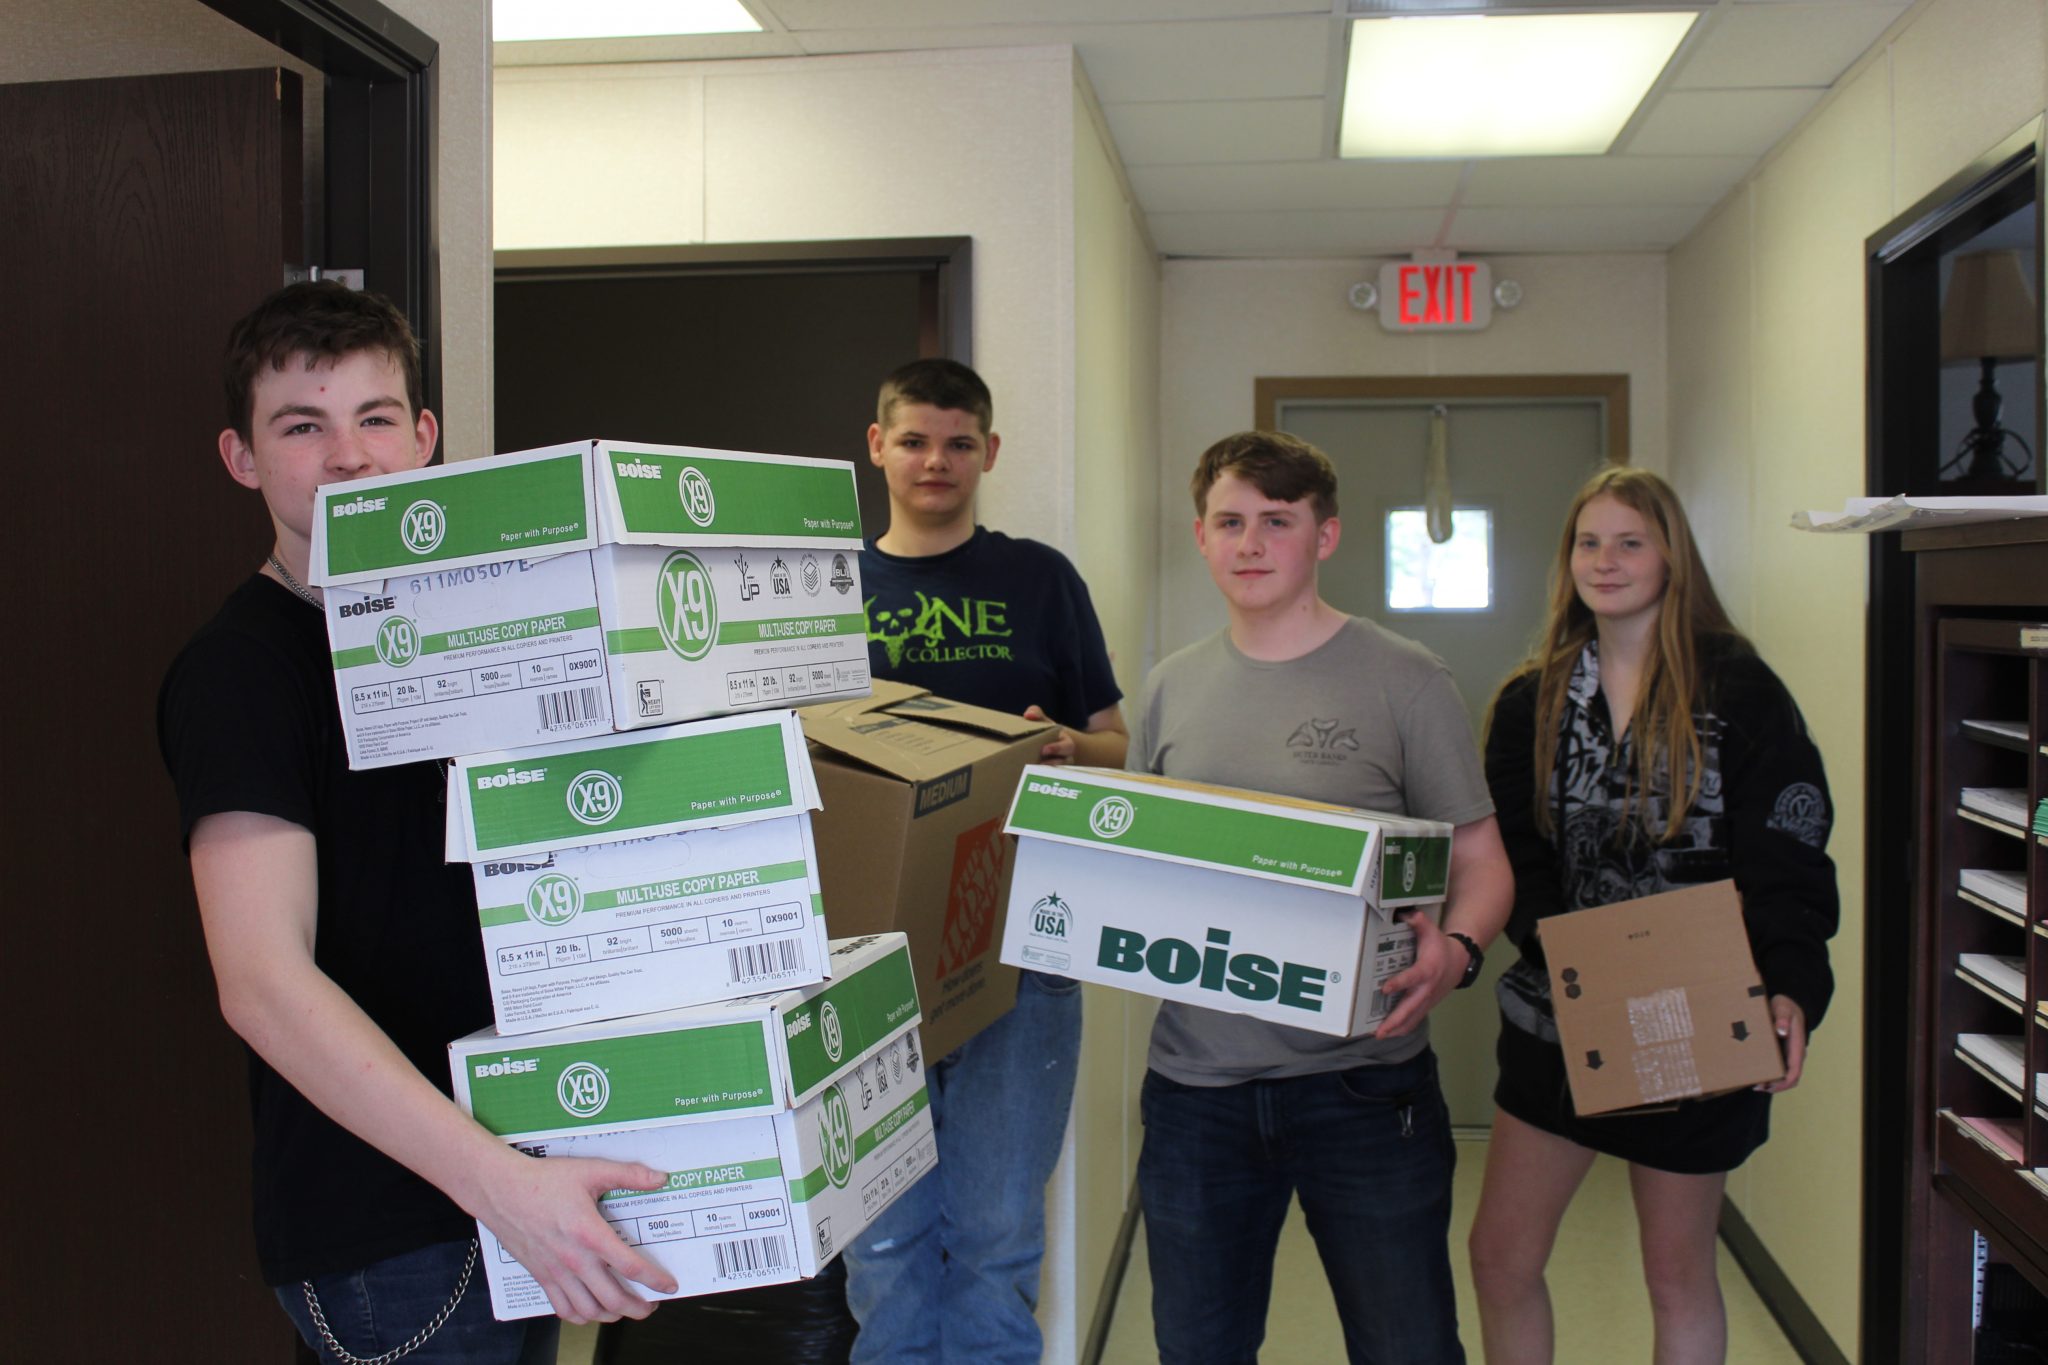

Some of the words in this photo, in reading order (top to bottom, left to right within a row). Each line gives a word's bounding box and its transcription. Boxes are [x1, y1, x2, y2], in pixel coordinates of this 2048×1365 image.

[1399, 265, 1477, 324] EXIT
[803, 517, 819, 529] Paper
[820, 518, 831, 529] with
[500, 530, 523, 543] Paper
[524, 527, 541, 539] with
[773, 577, 791, 595] USA
[447, 626, 499, 648] MULTI-USE
[501, 622, 529, 639] COPY
[531, 615, 567, 635] PAPER
[758, 621, 794, 639] MULTI-USE
[795, 619, 815, 635] COPY
[815, 618, 837, 634] PAPER
[443, 652, 465, 661] PREMIUM
[466, 646, 501, 659] PERFORMANCE
[516, 640, 537, 649] COPIERS
[538, 638, 548, 646] AND
[548, 634, 573, 643] PRINTERS
[906, 644, 1013, 662] COLLECTOR
[480, 671, 499, 681] 5000
[532, 664, 541, 673] 10
[812, 670, 824, 680] 5000
[437, 680, 447, 688] 92
[763, 676, 769, 686] 20
[789, 673, 796, 683] 92
[354, 693, 365, 702] 8.5
[373, 690, 380, 699] 11
[397, 686, 406, 695] 20
[408, 685, 417, 694] lb.
[920, 770, 967, 811] MEDIUM
[691, 799, 717, 811] Paper
[719, 795, 737, 807] with
[1252, 854, 1277, 868] Paper
[1279, 859, 1298, 872] with
[616, 882, 680, 906] MULTI-USE
[682, 876, 717, 895] COPY
[718, 870, 760, 890] PAPER
[615, 909, 642, 919] PREMIUM
[643, 902, 684, 914] PERFORMANCE
[693, 899, 703, 907] ALL
[704, 895, 729, 905] COPIERS
[730, 893, 742, 901] AND
[743, 889, 771, 899] PRINTERS
[722, 918, 733, 928] 10
[1035, 913, 1066, 937] USA
[660, 926, 683, 938] 5000
[606, 937, 618, 946] 92
[501, 953, 514, 963] 8.5
[525, 949, 533, 959] 11
[535, 949, 546, 957] in.
[556, 945, 567, 955] 20
[569, 944, 581, 953] lb.
[675, 1097, 700, 1108] Paper
[701, 1092, 719, 1104] with
[671, 1172, 701, 1187] COPY
[705, 1165, 745, 1183] PAPER
[604, 1201, 630, 1210] PREMIUM
[630, 1195, 671, 1208] PERFORMANCE
[678, 1192, 688, 1200] ALL
[689, 1189, 712, 1198] COPIERS
[713, 1187, 725, 1195] AND
[726, 1184, 753, 1194] PRINTERS
[648, 1220, 669, 1230] 5000
[706, 1213, 717, 1223] 10
